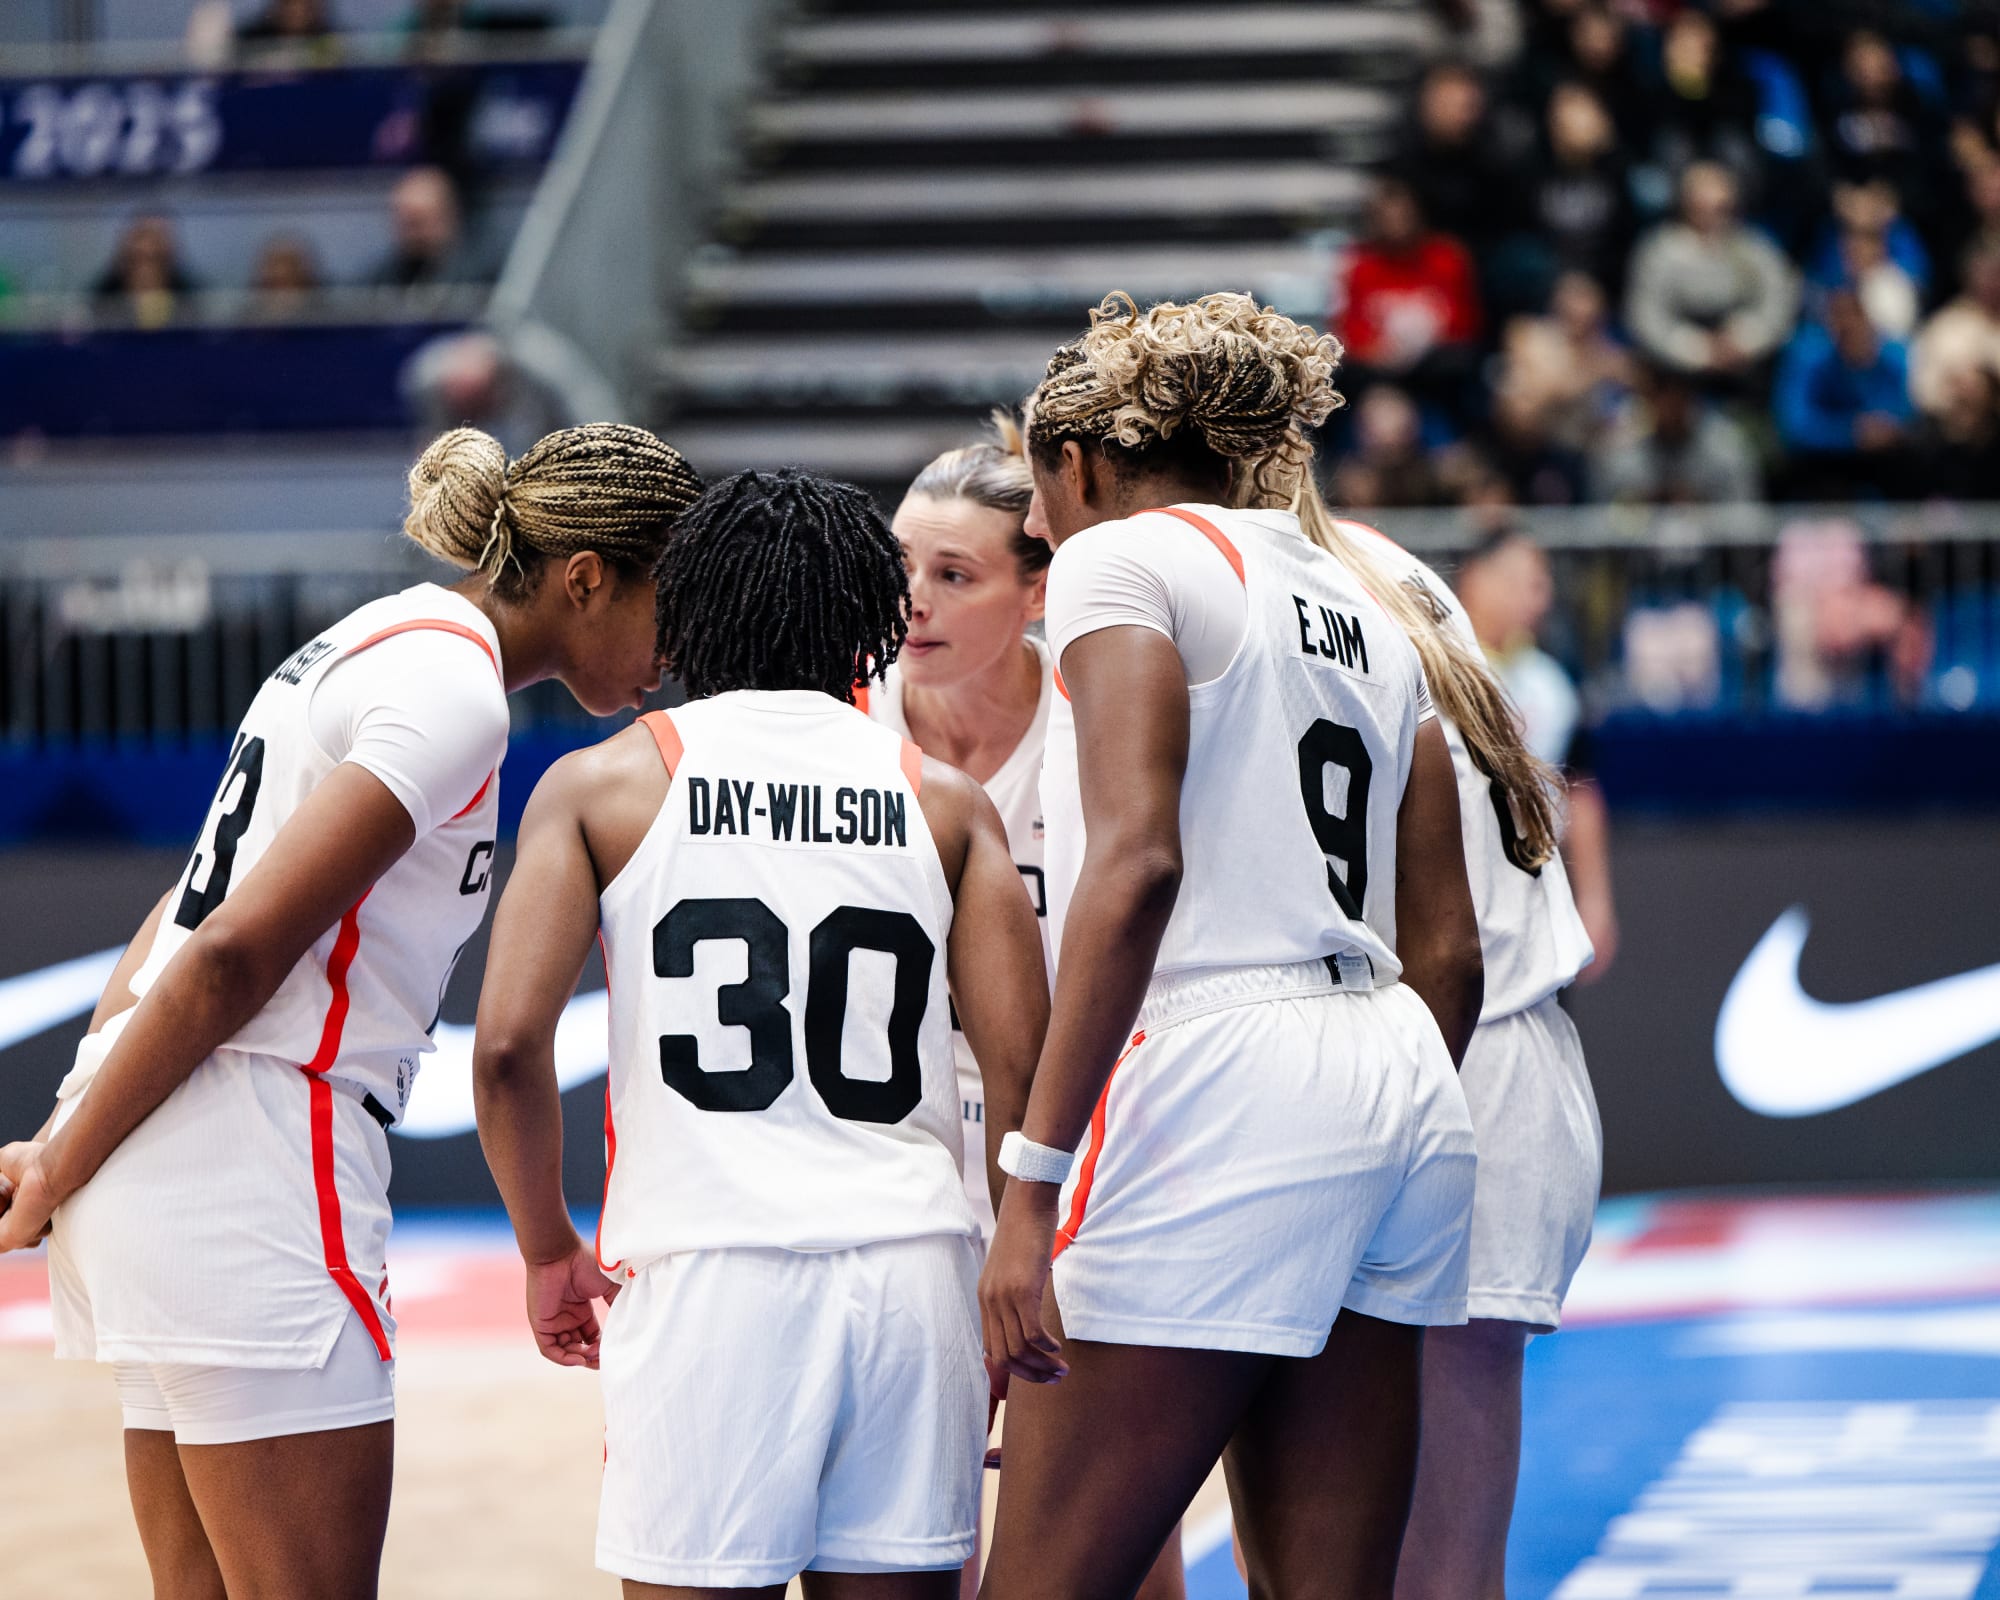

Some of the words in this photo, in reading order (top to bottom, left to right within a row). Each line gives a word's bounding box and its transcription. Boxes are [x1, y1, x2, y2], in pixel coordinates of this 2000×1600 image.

[1292, 594, 1369, 674] EJIM
[174, 732, 265, 932] 3
[688, 777, 907, 847] DAY-WILSON
[1298, 717, 1373, 921] 9
[652, 897, 936, 1125] 30
